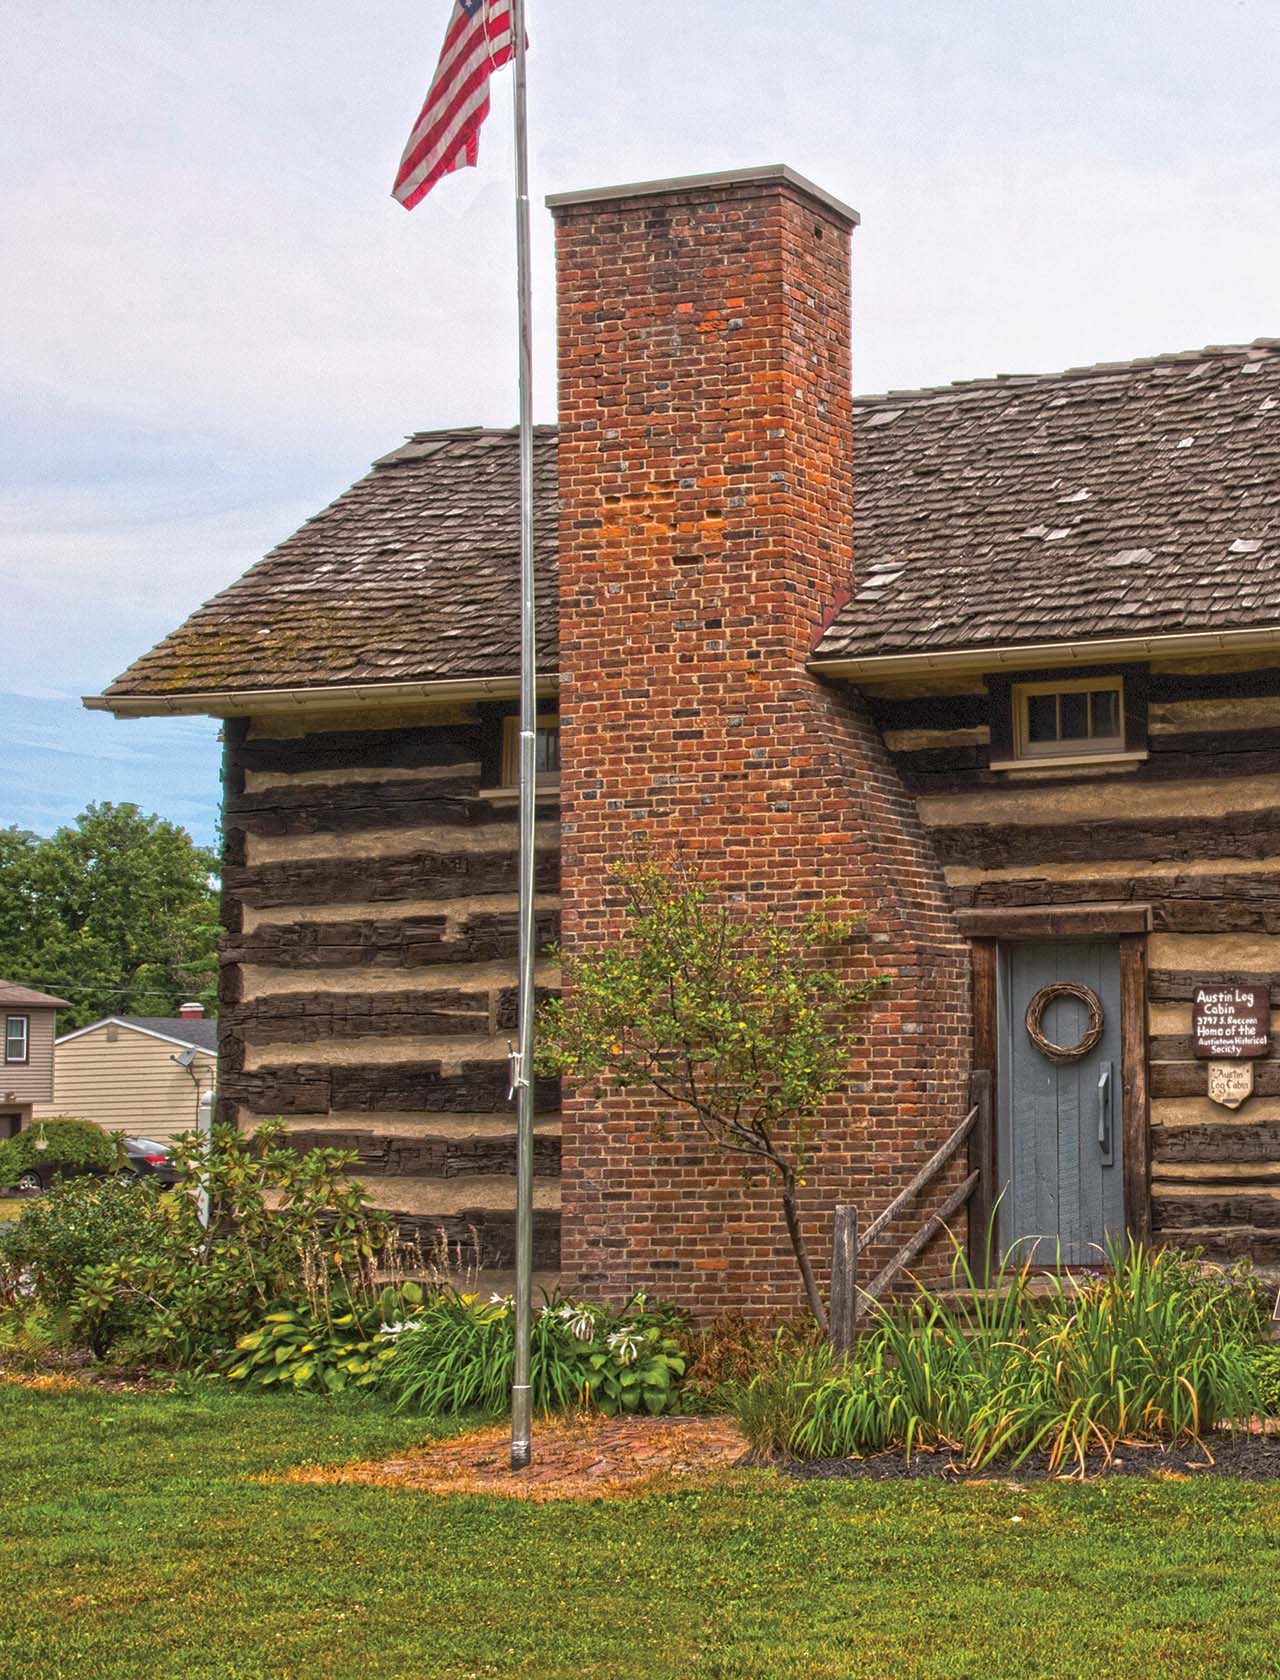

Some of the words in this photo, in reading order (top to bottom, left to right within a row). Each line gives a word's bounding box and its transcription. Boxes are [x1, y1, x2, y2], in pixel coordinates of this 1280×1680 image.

[1197, 988, 1232, 1003] Austin
[1235, 989, 1254, 1007] Log
[1204, 1003, 1235, 1014] Cabin
[1227, 1016, 1257, 1024] Raccoon
[1197, 1026, 1224, 1036] Home
[1225, 1025, 1236, 1035] of
[1238, 1024, 1256, 1035] the
[1234, 1035, 1267, 1044] Historical
[1211, 1045, 1242, 1056] Society
[1214, 1069, 1243, 1078] Austin
[1211, 1080, 1226, 1093] Log
[1226, 1080, 1248, 1089] Cabin
